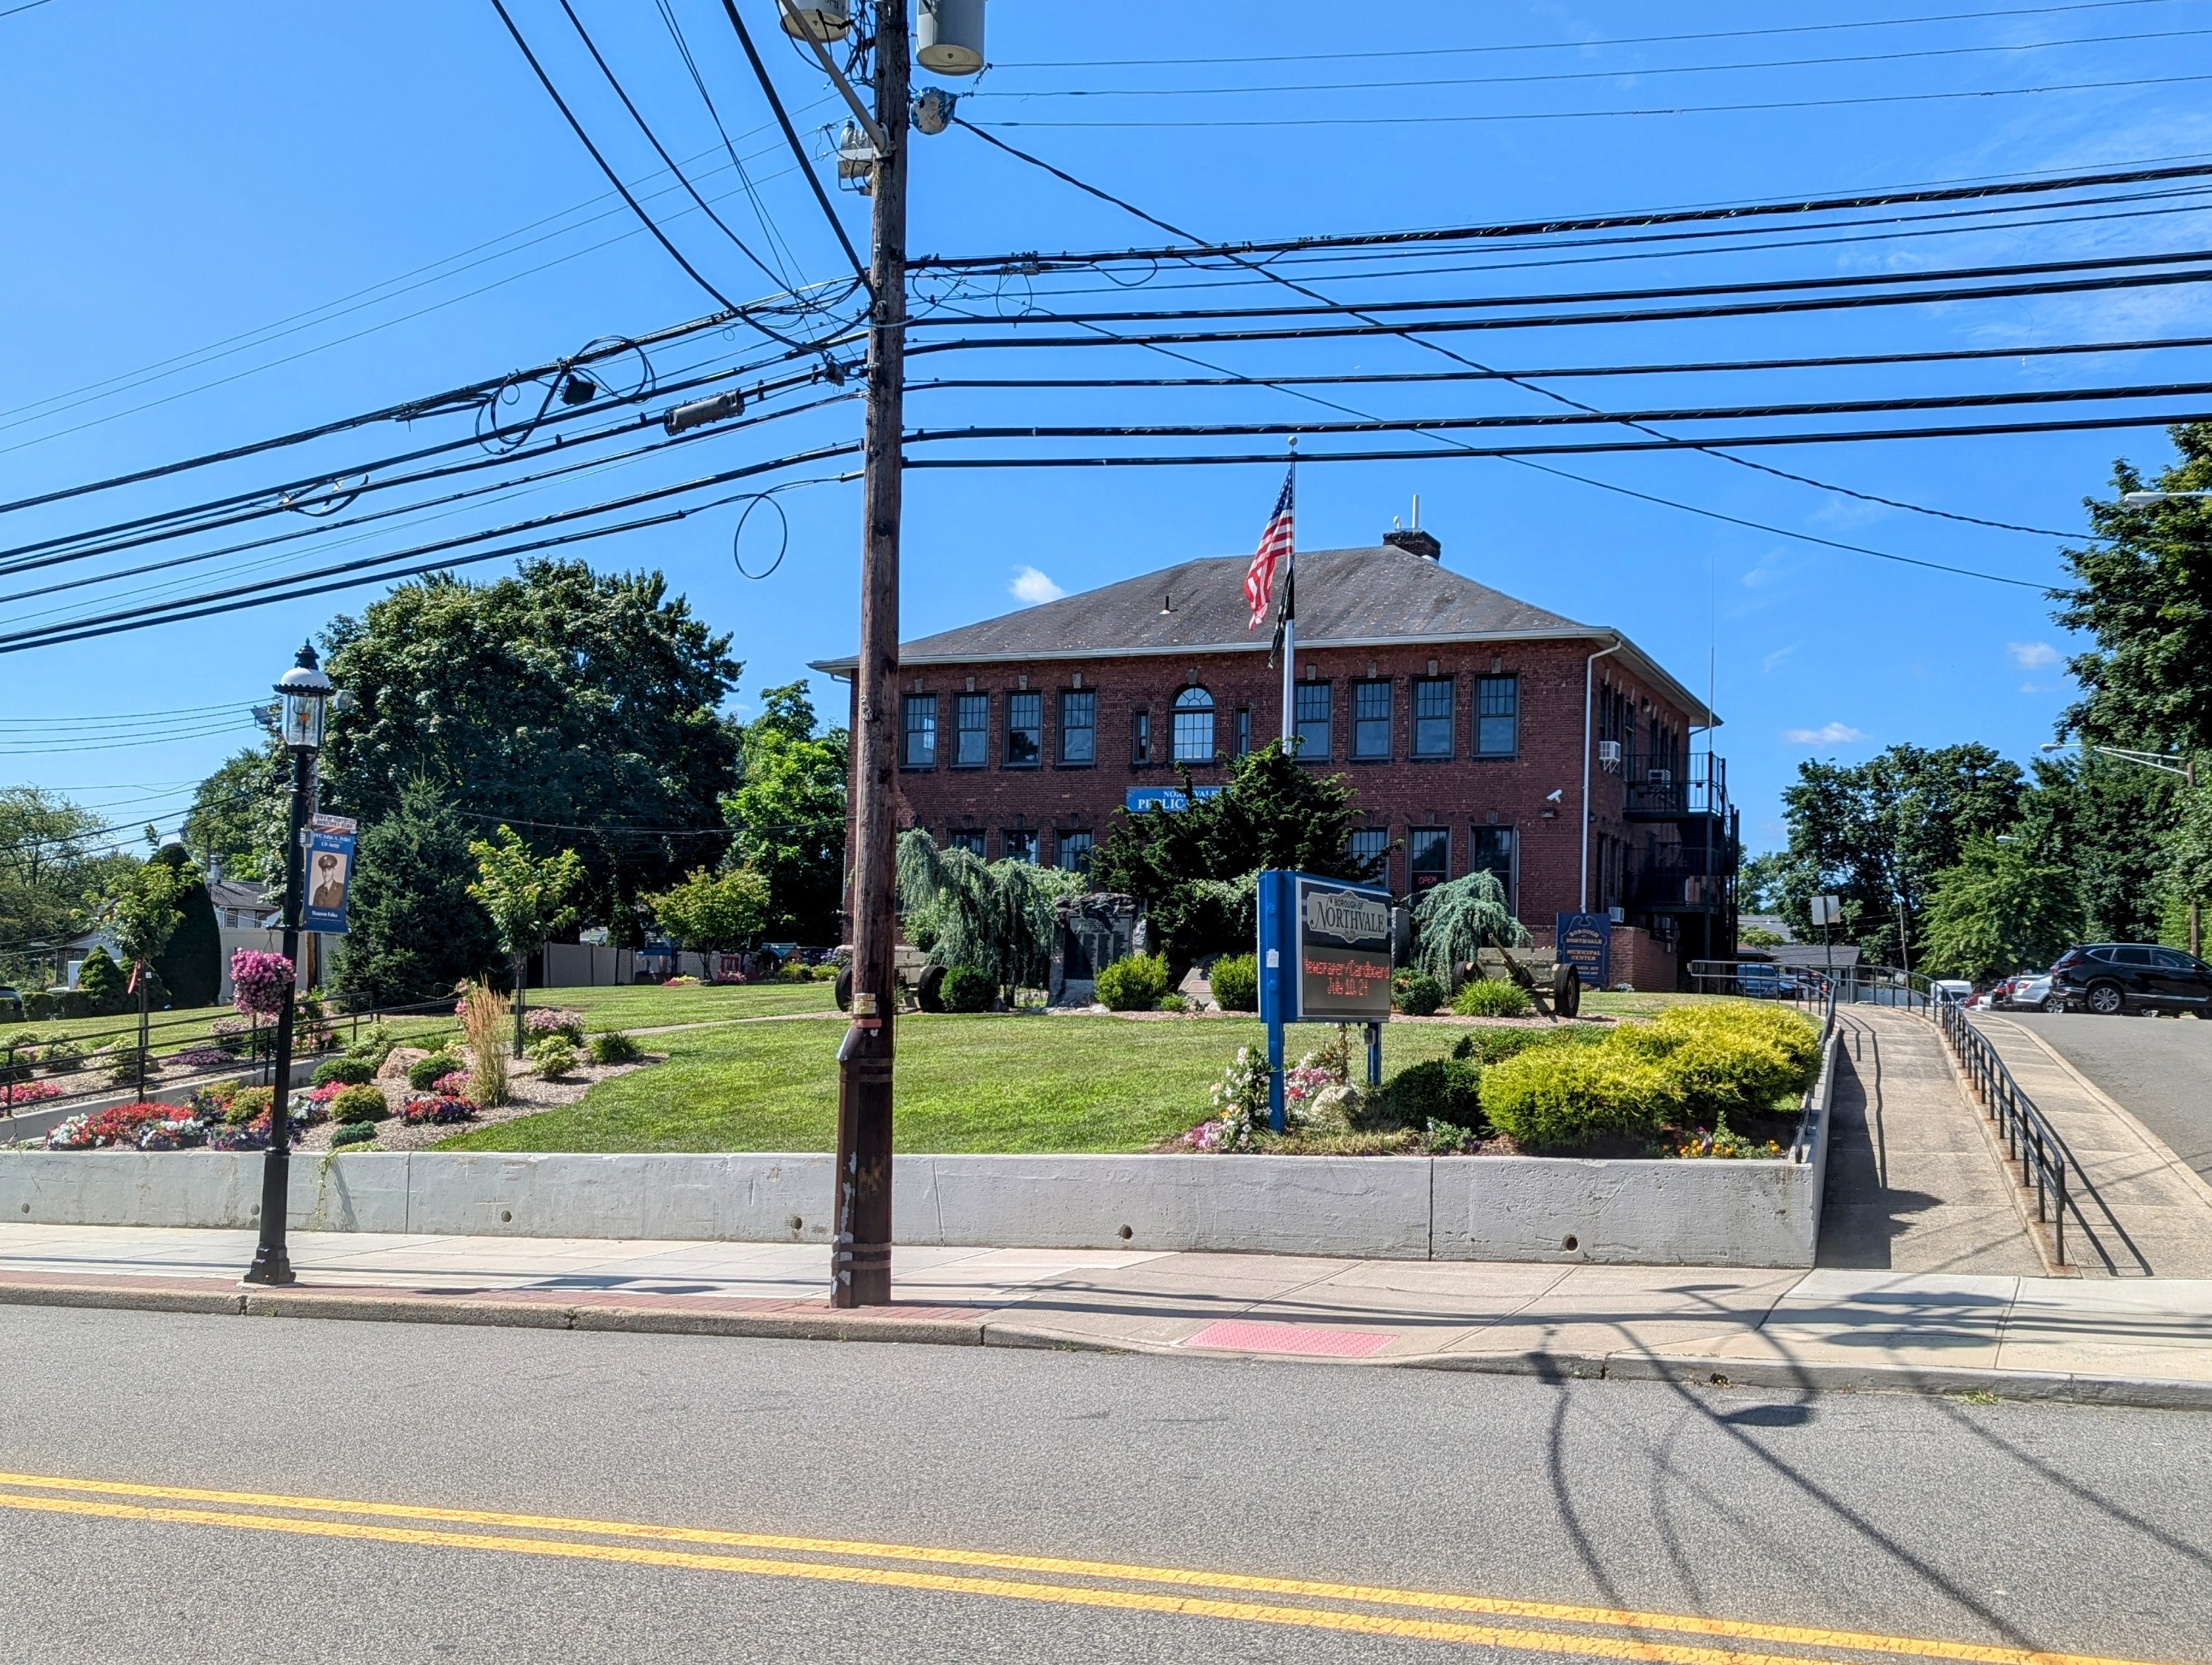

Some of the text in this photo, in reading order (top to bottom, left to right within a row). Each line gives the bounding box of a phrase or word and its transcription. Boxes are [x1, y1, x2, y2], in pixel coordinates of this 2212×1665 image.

[1137, 799, 1184, 809] PLIC
[1418, 876, 1437, 885] OPEN
[1334, 898, 1364, 910] BOROUGH OF
[1310, 896, 1385, 933] NORTHVALE
[1569, 929, 1600, 938] BOROUGH
